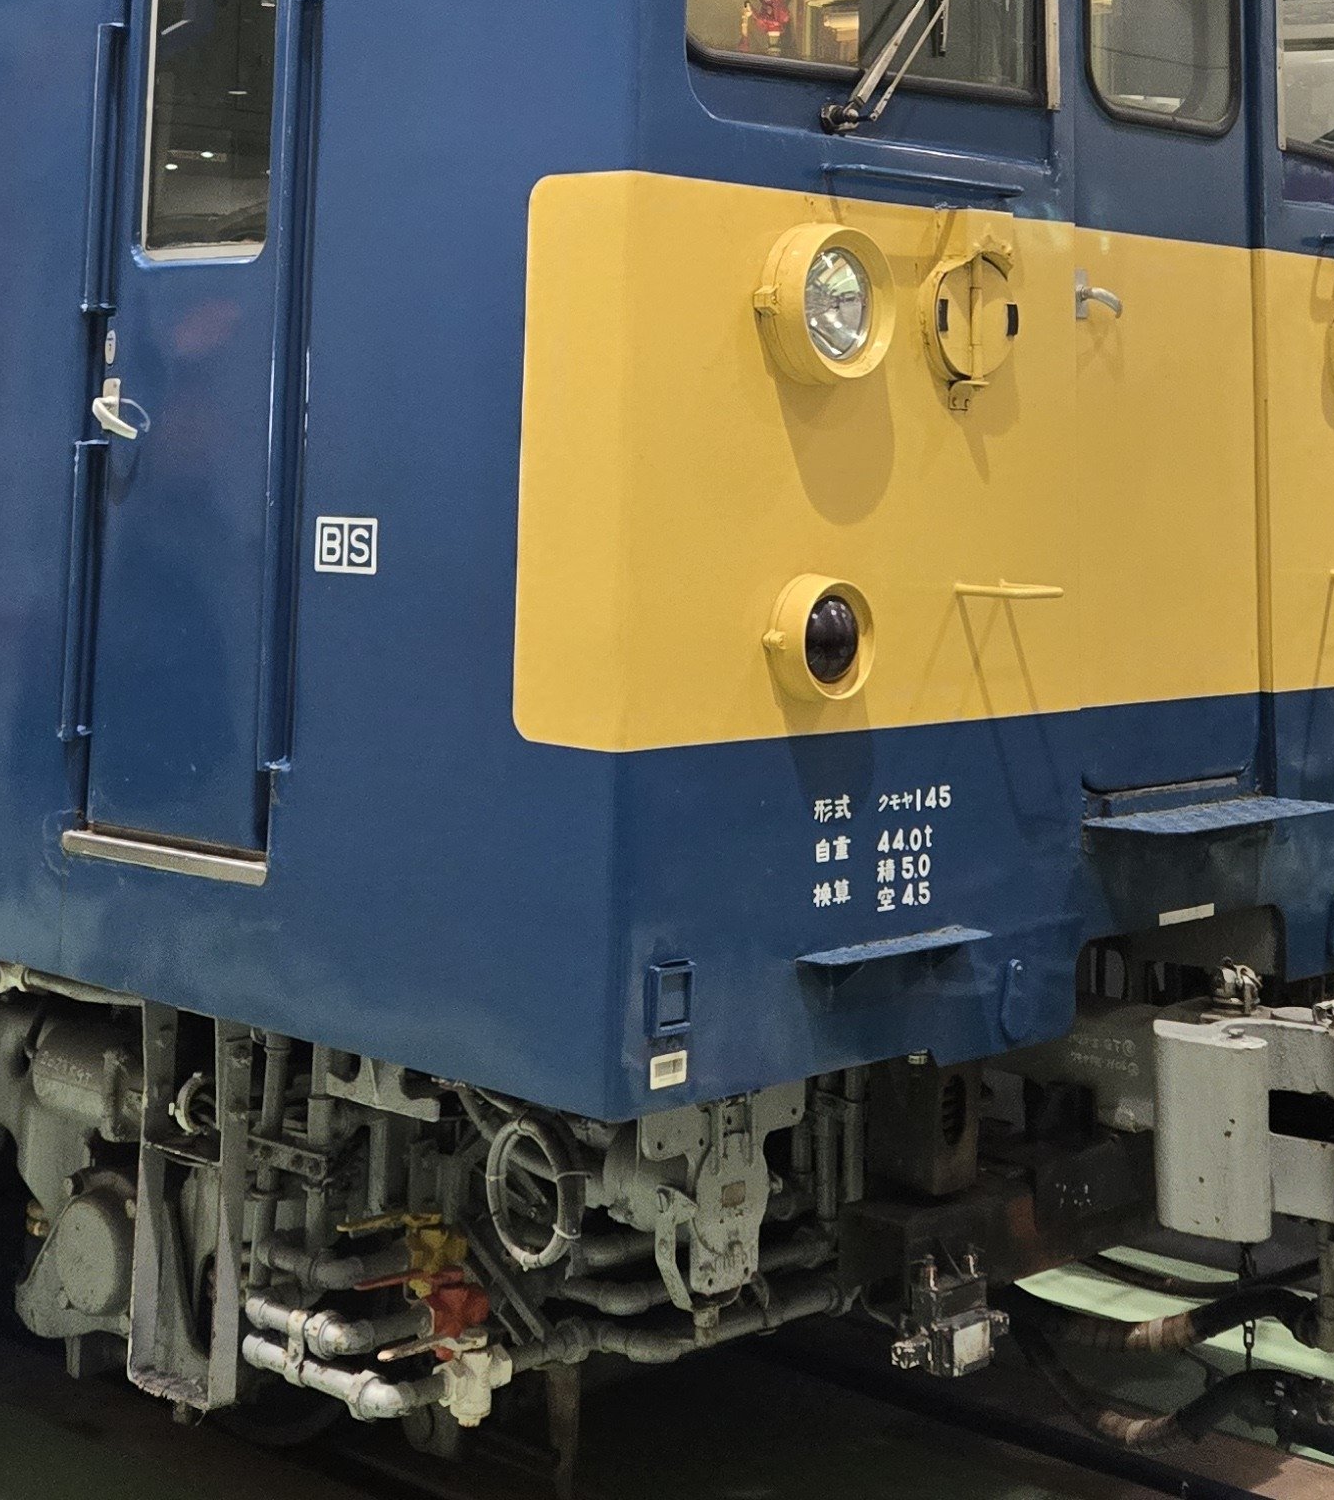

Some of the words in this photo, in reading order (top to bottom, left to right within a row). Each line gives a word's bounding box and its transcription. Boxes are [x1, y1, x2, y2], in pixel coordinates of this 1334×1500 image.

[321, 526, 370, 564] BS
[814, 794, 852, 823] 形式
[878, 785, 952, 812] クモヤ145
[815, 835, 851, 863] 自重
[877, 824, 933, 853] 44.0t
[813, 878, 851, 908] 換算
